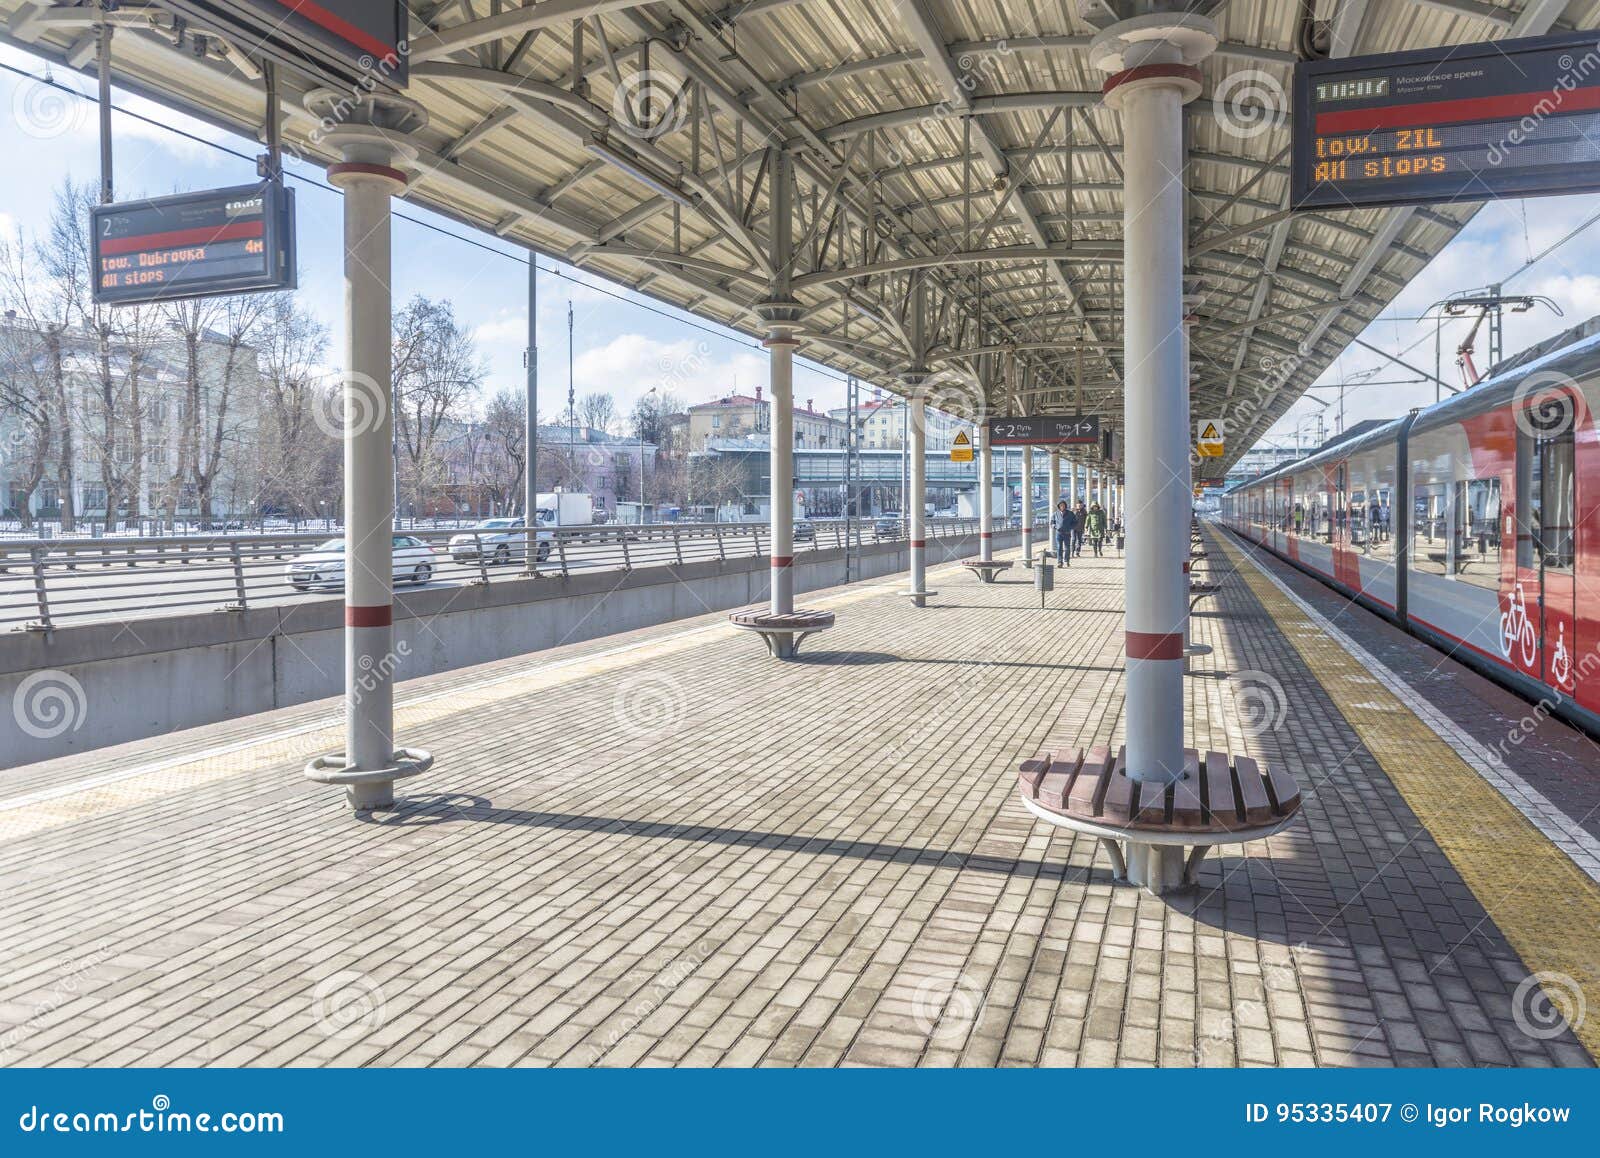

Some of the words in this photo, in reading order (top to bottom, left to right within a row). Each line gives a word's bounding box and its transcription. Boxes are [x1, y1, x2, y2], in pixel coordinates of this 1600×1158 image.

[1396, 73, 1453, 86] Московское
[1454, 69, 1484, 81] время
[1316, 137, 1377, 158] tow.
[1396, 128, 1441, 150] ZIL
[1364, 156, 1445, 178] stops
[103, 218, 113, 236] 2
[102, 257, 132, 272] tow.
[138, 248, 206, 268] Dubrovka
[125, 269, 164, 285] stops
[1007, 424, 1016, 437] 2
[1073, 423, 1080, 436] 1
